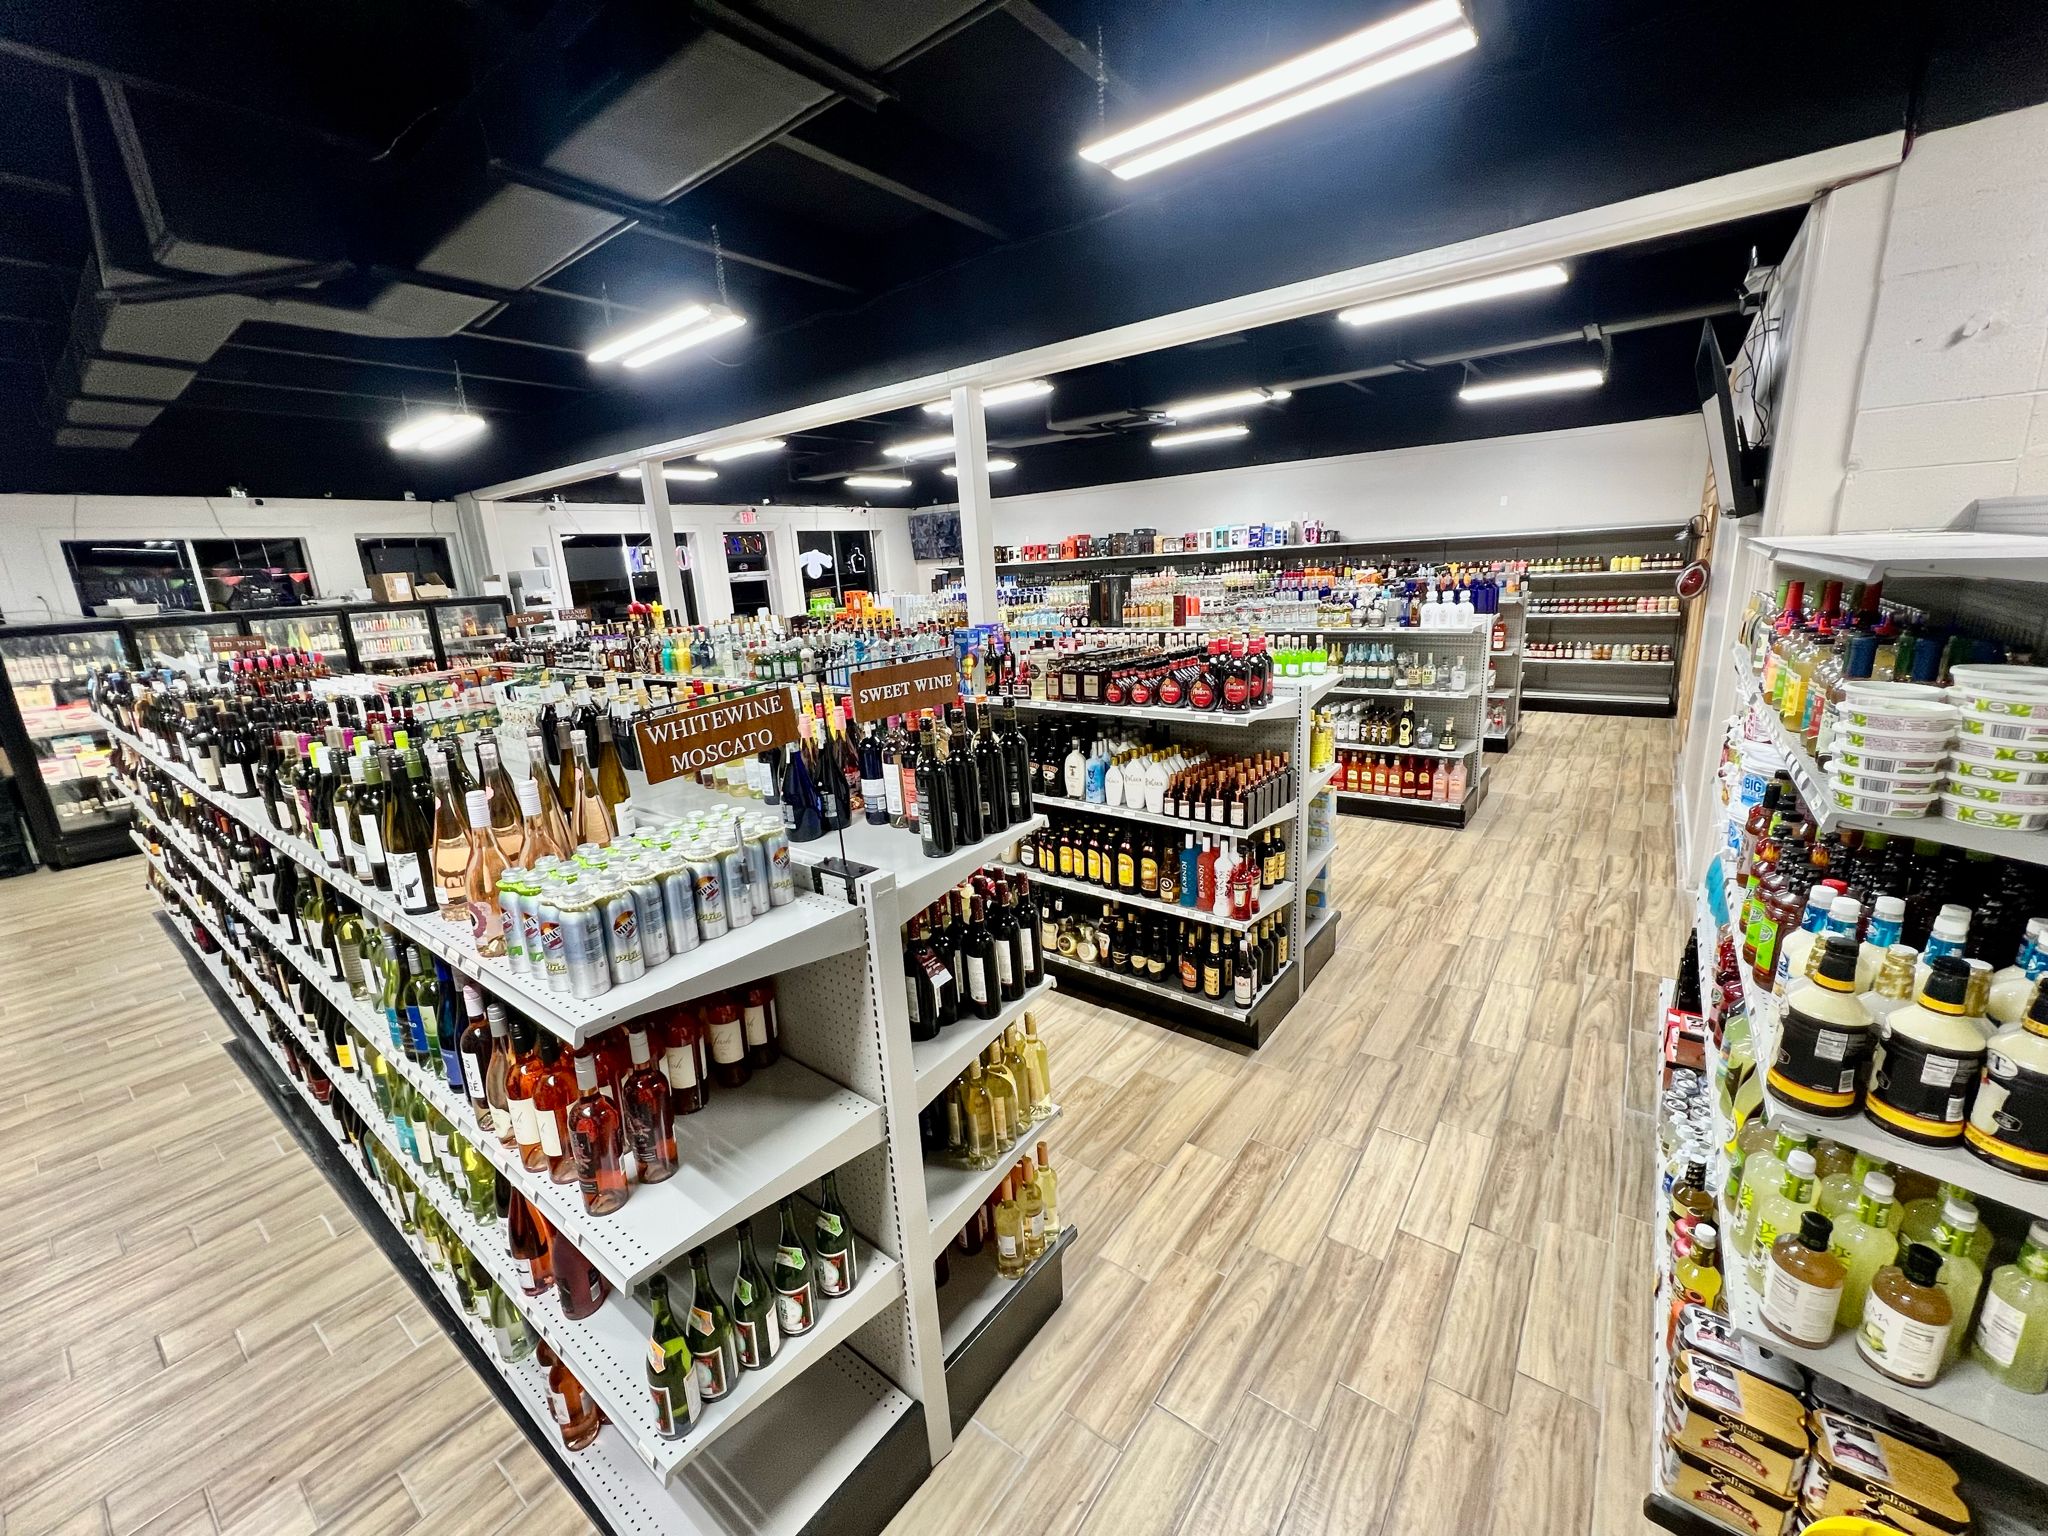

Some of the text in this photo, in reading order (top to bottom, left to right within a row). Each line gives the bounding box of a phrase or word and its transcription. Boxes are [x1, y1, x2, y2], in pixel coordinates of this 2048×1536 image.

[742, 511, 756, 524] EXIT
[517, 616, 535, 624] RUM
[858, 673, 954, 705] SWEET WINE
[645, 694, 784, 746] WHITEWINE
[669, 728, 774, 774] MOSCATO
[1744, 777, 1762, 793] BIG
[1719, 1414, 1765, 1443] Goslings
[1708, 1440, 1742, 1458] GINGER
[1710, 1466, 1756, 1496] Goslings
[1865, 1483, 1920, 1515] Goslings
